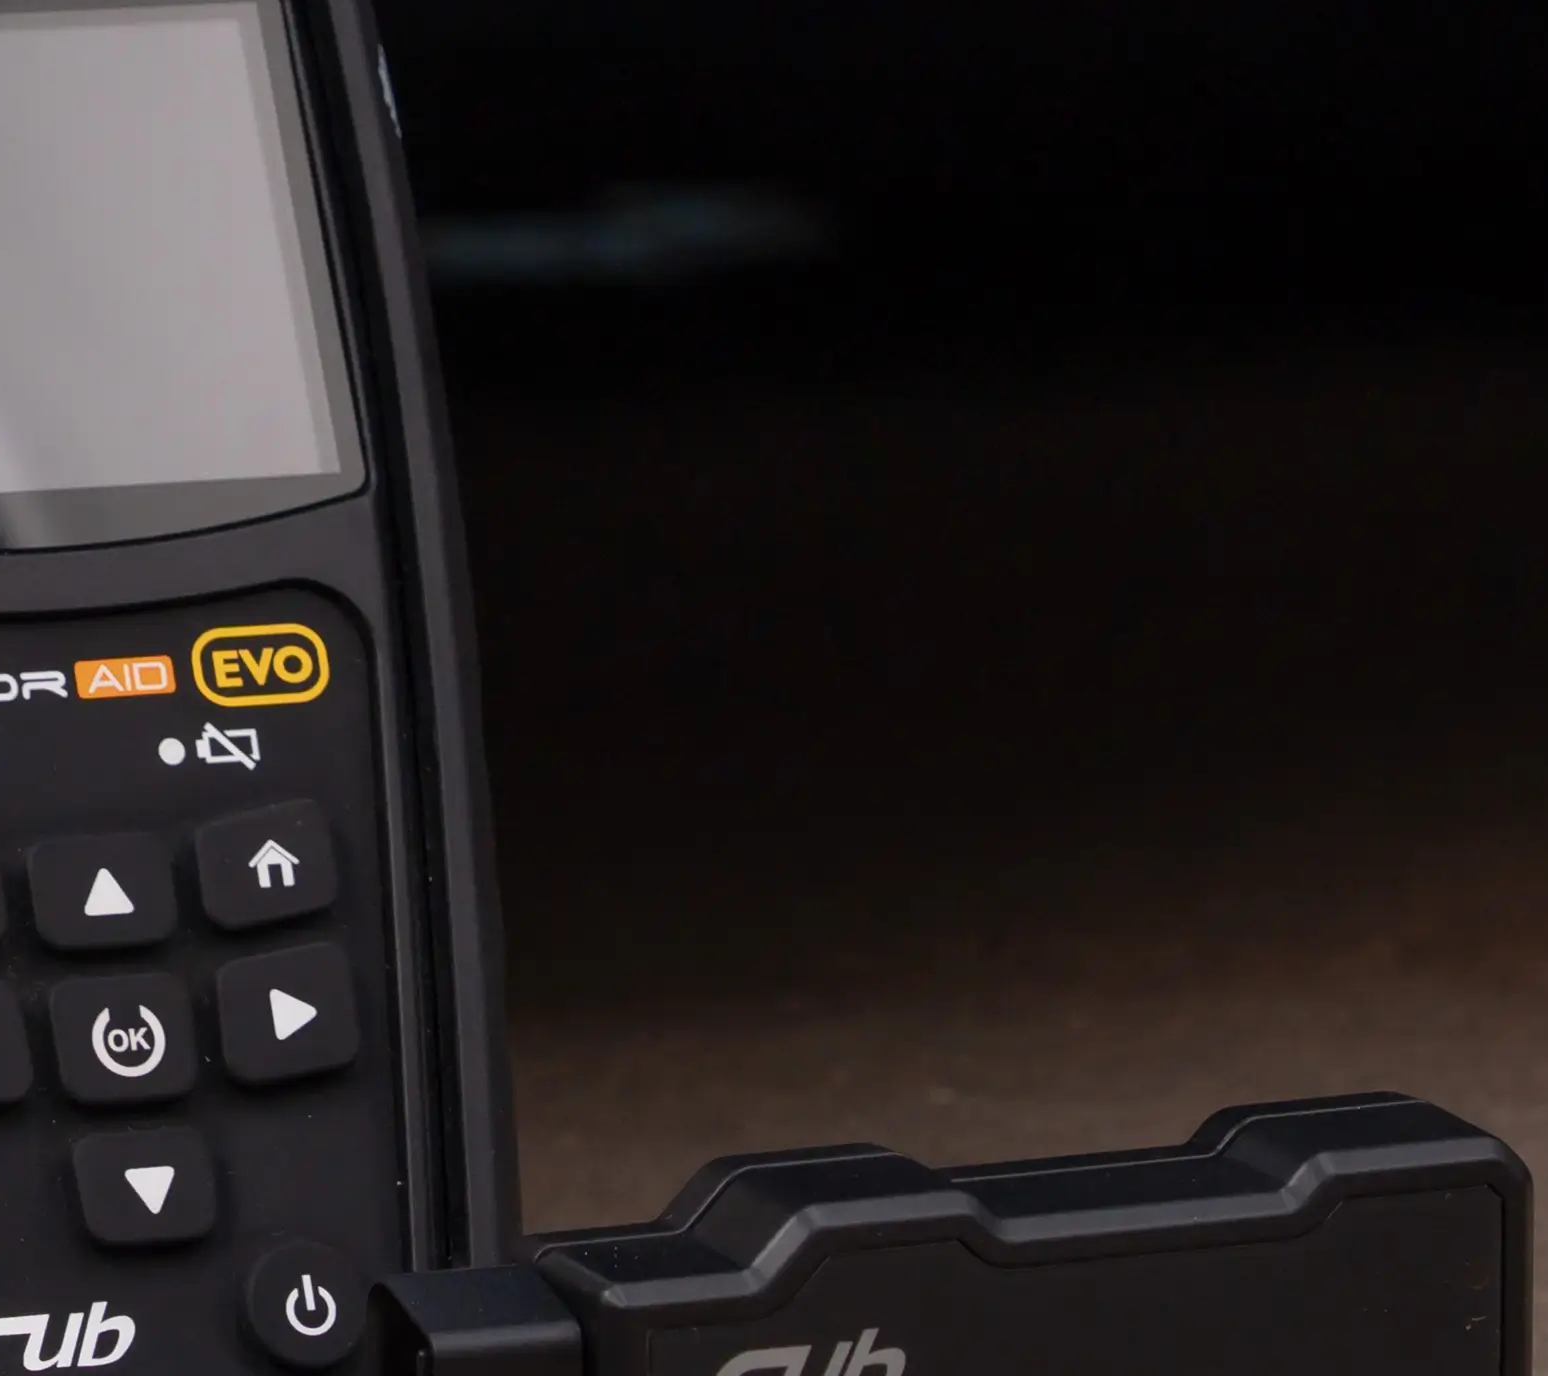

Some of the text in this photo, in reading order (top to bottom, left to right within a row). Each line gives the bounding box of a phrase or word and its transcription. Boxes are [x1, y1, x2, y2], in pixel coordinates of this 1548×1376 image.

[87, 660, 169, 694] AID
[211, 644, 314, 688] EVO
[107, 1026, 151, 1053] OK
